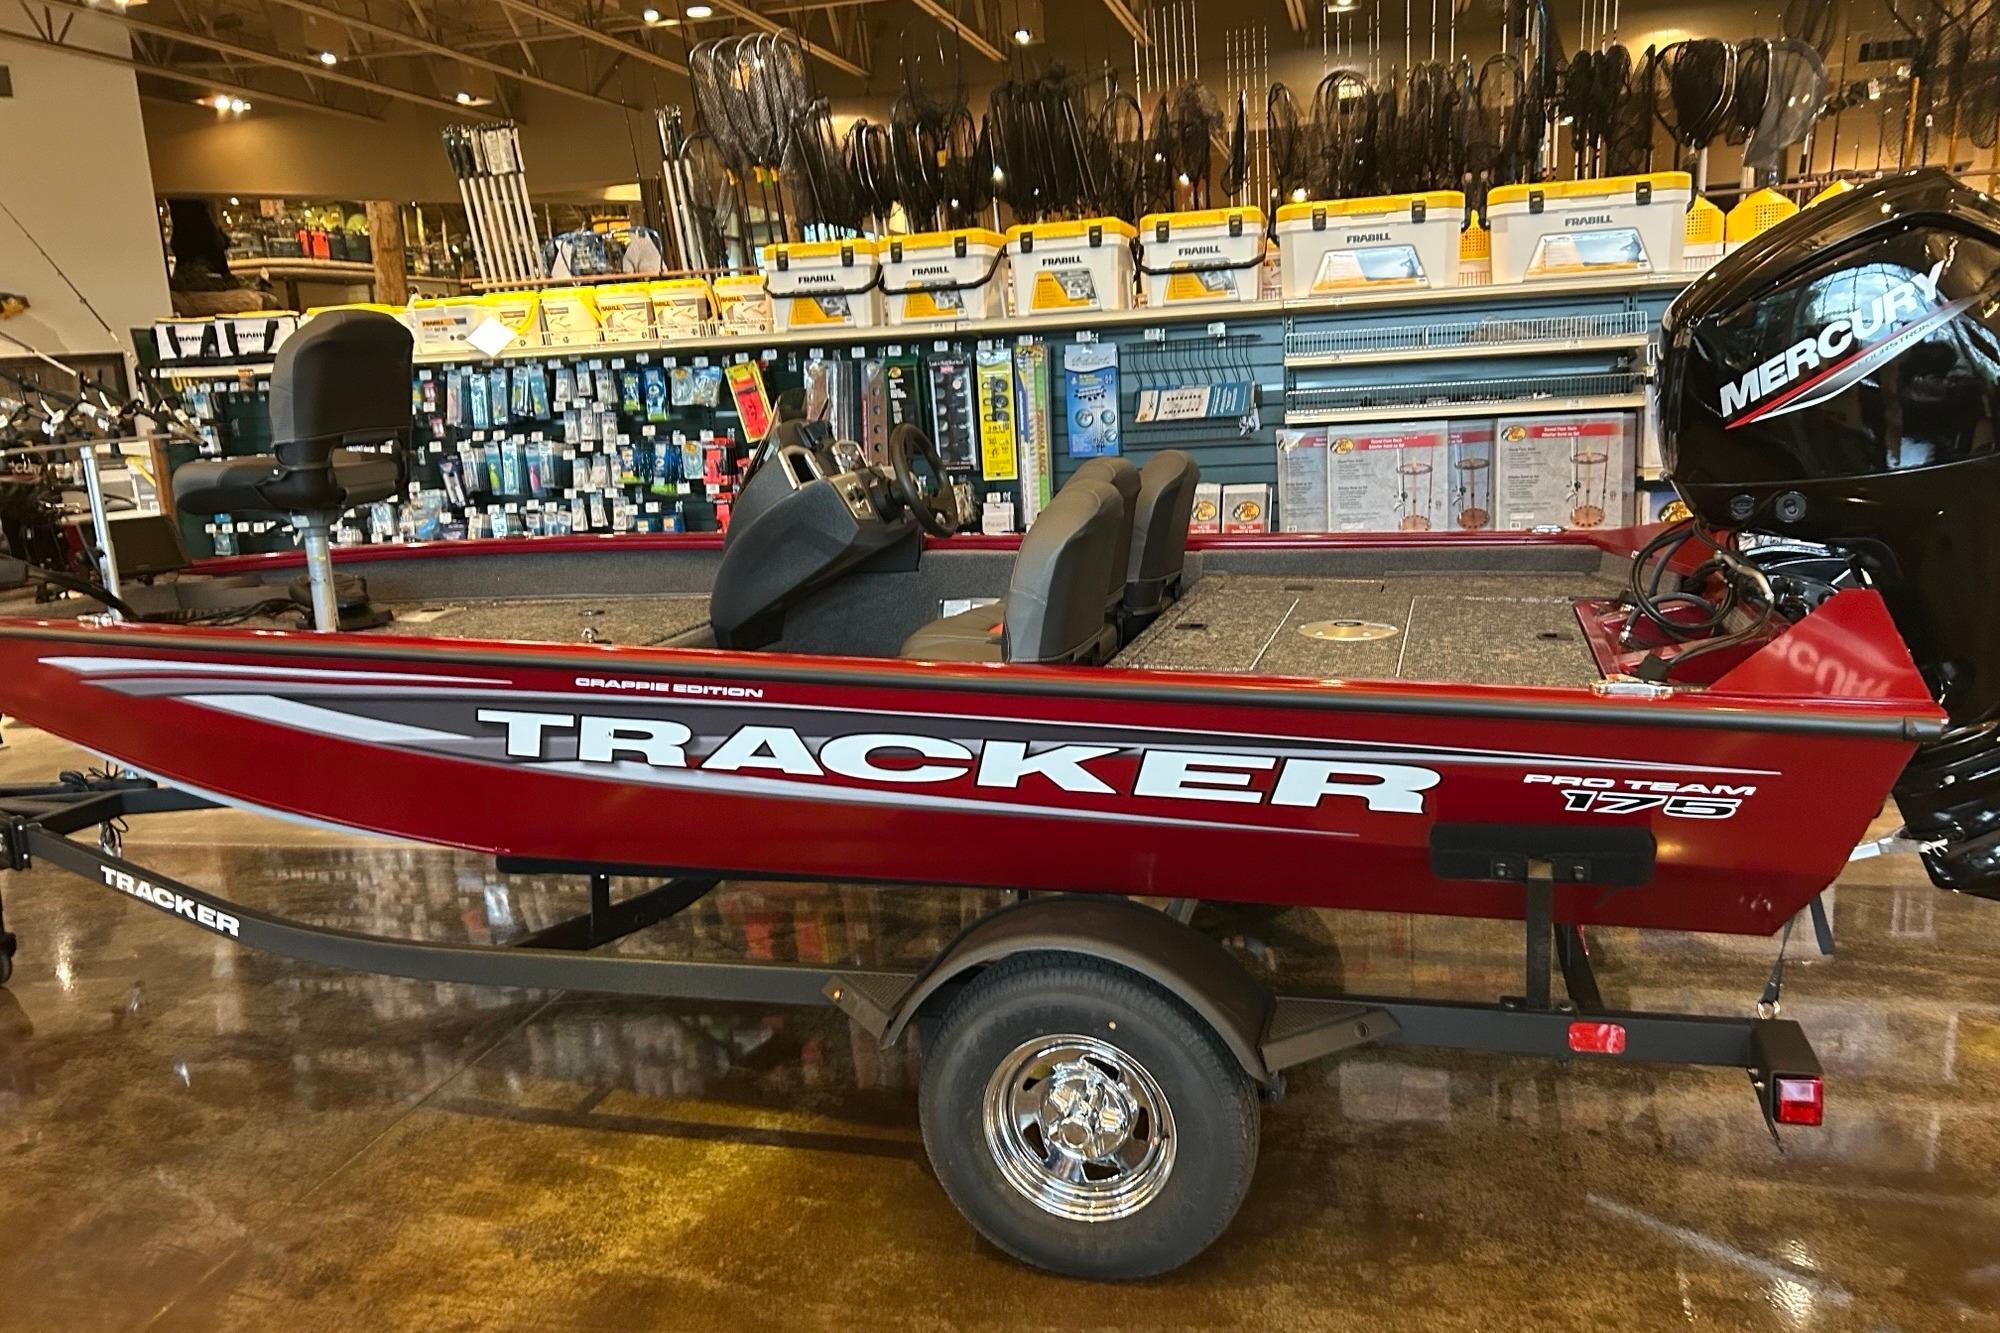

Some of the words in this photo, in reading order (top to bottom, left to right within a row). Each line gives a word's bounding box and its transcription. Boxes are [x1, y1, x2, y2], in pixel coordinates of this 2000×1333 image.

[1564, 214, 1613, 227] FRABILL
[1346, 232, 1392, 244] FRABILL
[1178, 245, 1221, 257] FRABILL
[1042, 256, 1082, 267] FRABILL
[912, 266, 950, 277] FRABILL
[797, 274, 836, 285] FRABILL
[1719, 260, 1945, 418] MERCURY
[673, 684, 764, 698] EDITION
[477, 708, 1443, 814] TRACKER
[1523, 774, 1616, 788] PRO
[1624, 779, 1757, 796] TEAM
[1561, 789, 1743, 819] 175
[100, 865, 240, 937] TRACKER
